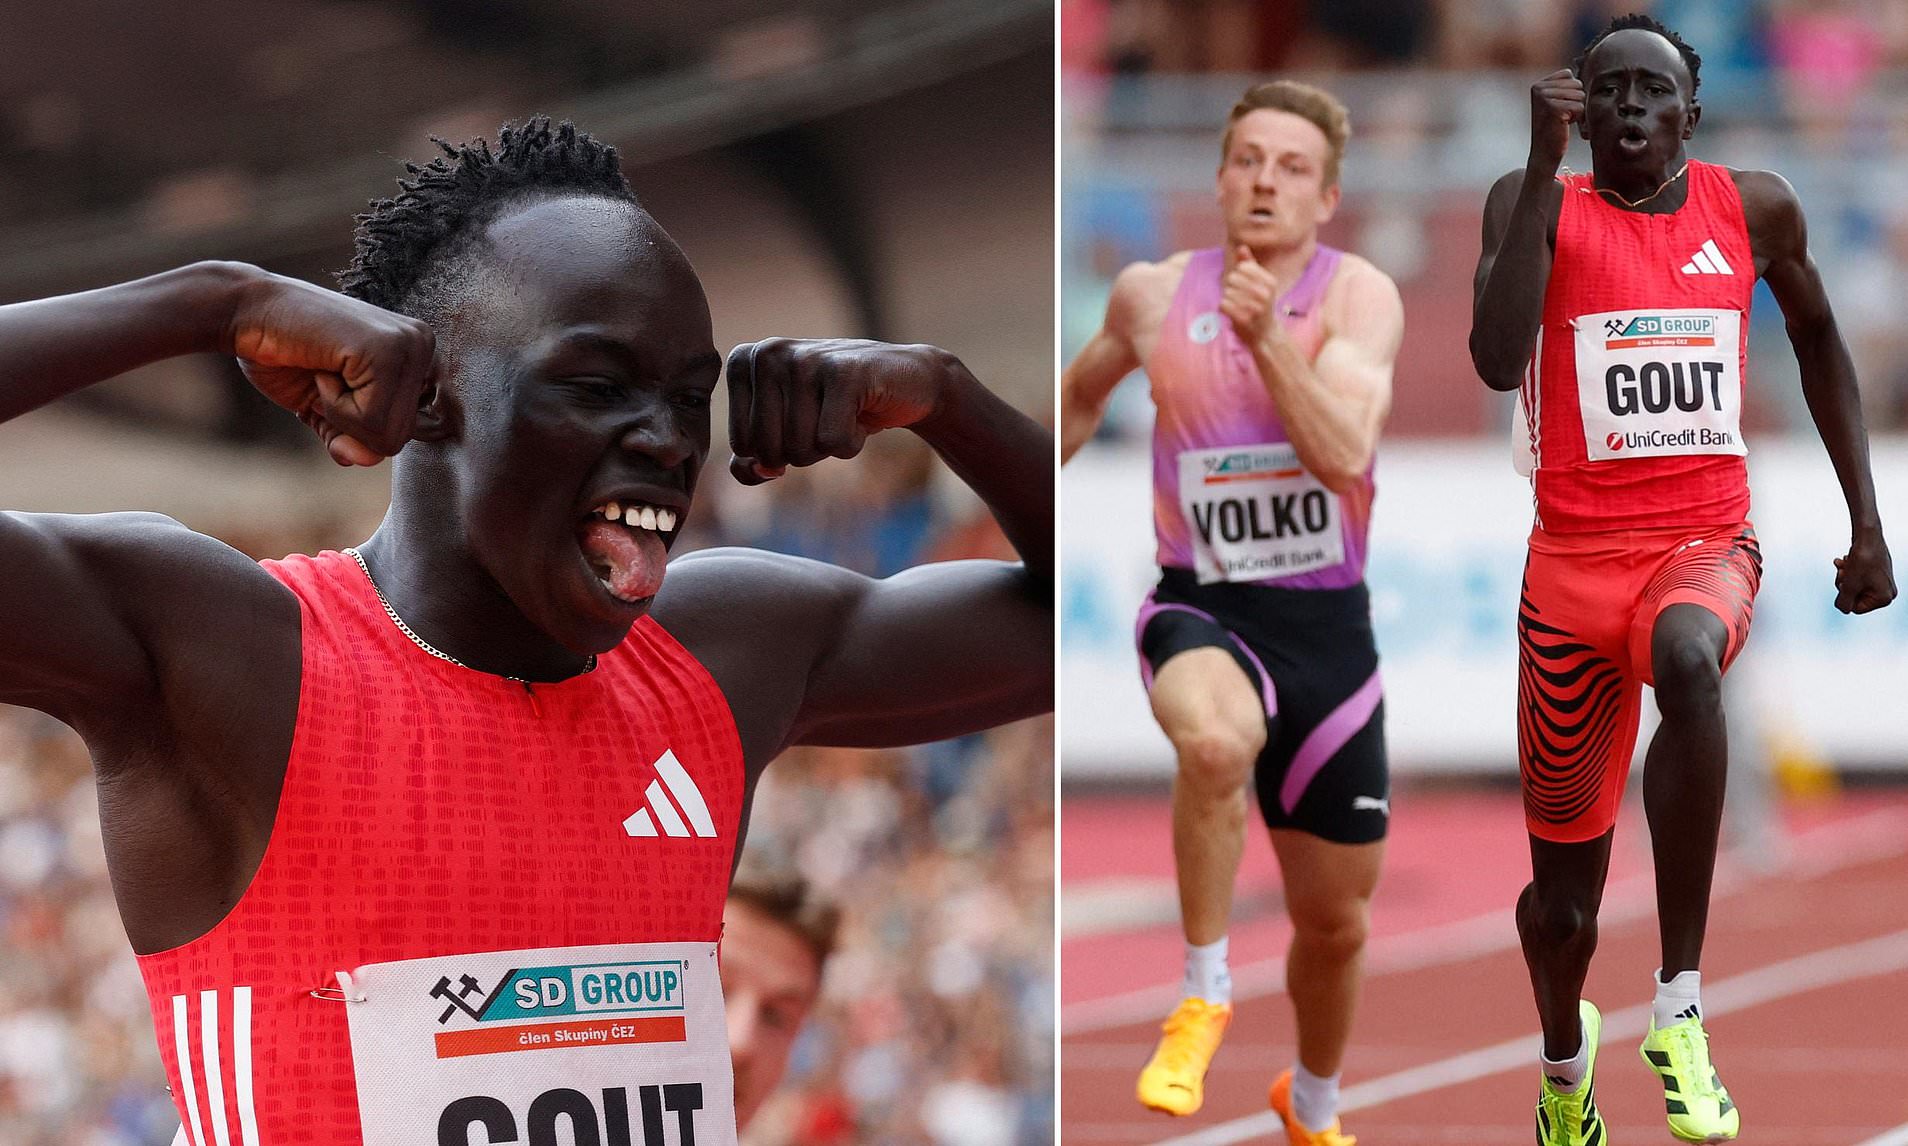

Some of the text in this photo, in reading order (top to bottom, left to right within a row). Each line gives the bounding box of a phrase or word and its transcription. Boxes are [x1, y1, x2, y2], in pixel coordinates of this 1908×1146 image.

[1637, 319, 1710, 332] SD GROUP
[1605, 361, 1724, 416] GOUT
[1625, 429, 1696, 448] UniCredit
[1192, 489, 1329, 545] VOLKO
[514, 970, 678, 1010] SD GROUP
[519, 1023, 636, 1045] člen Skupiny ČEZ
